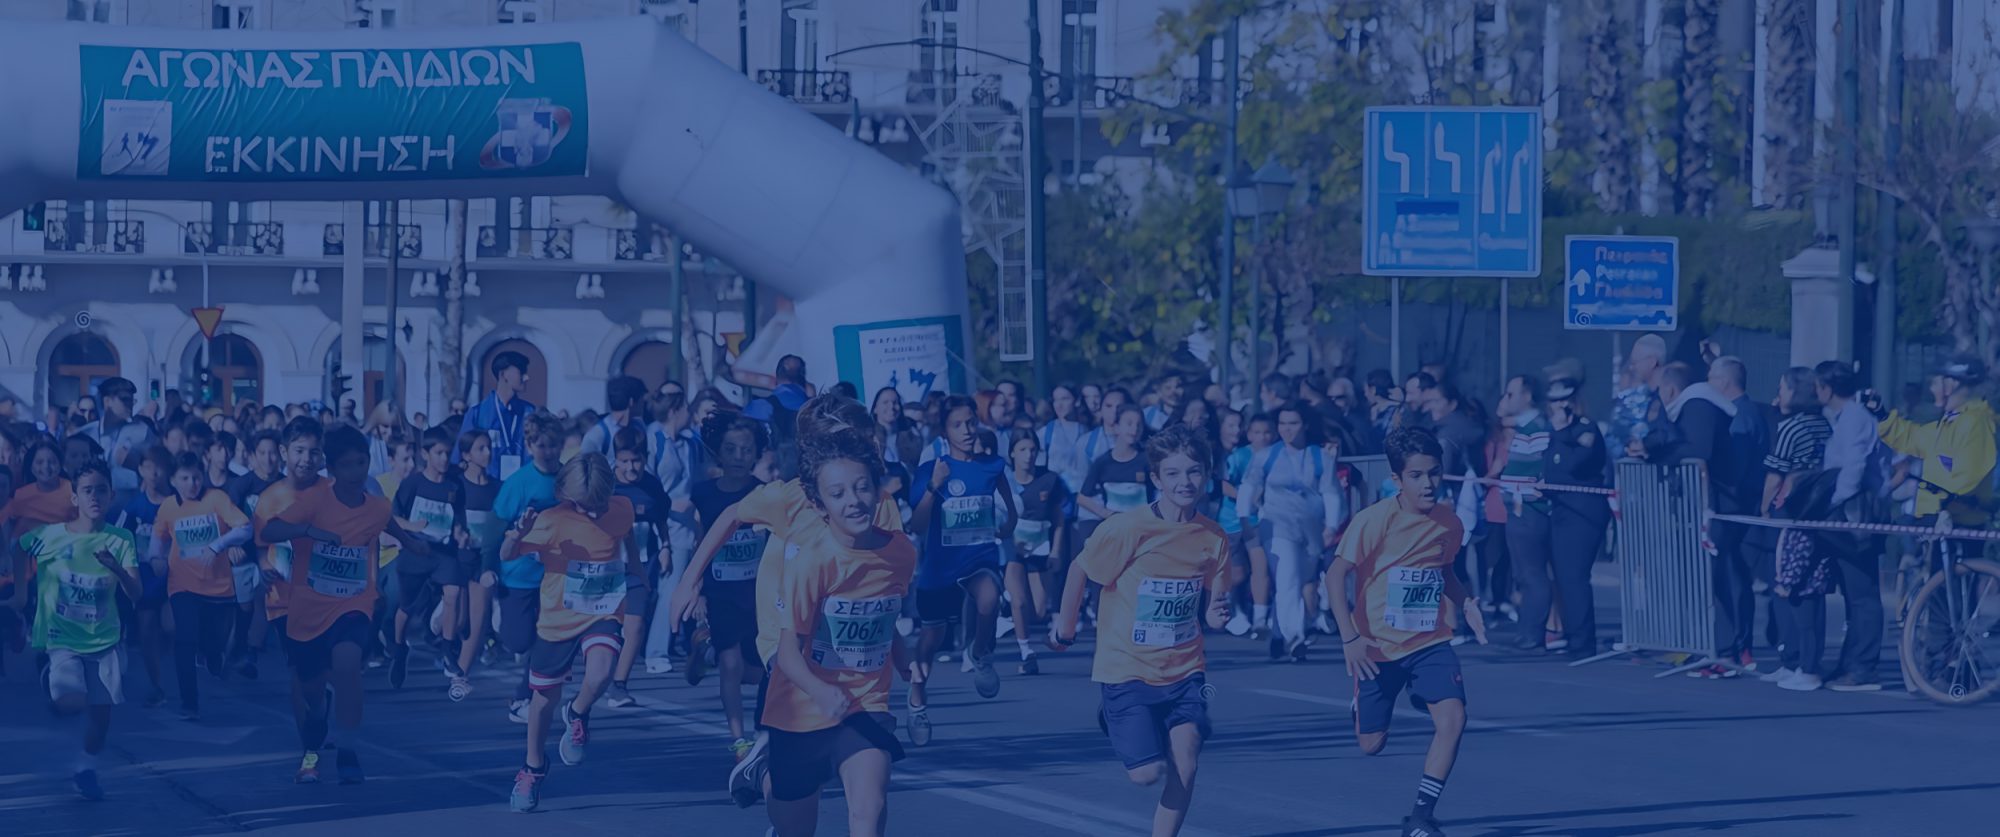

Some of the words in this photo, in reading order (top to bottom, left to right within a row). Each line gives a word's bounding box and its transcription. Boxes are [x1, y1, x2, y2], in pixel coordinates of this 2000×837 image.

[121, 49, 324, 88] ΑΓΩΝΑΣ
[330, 47, 536, 89] ΠΑΙΔΙΩΝ
[204, 134, 456, 174] ΕΚΚΙΝΗΣΗ
[321, 558, 358, 577] 70671
[834, 598, 897, 616] ΣΕΓΑΣ
